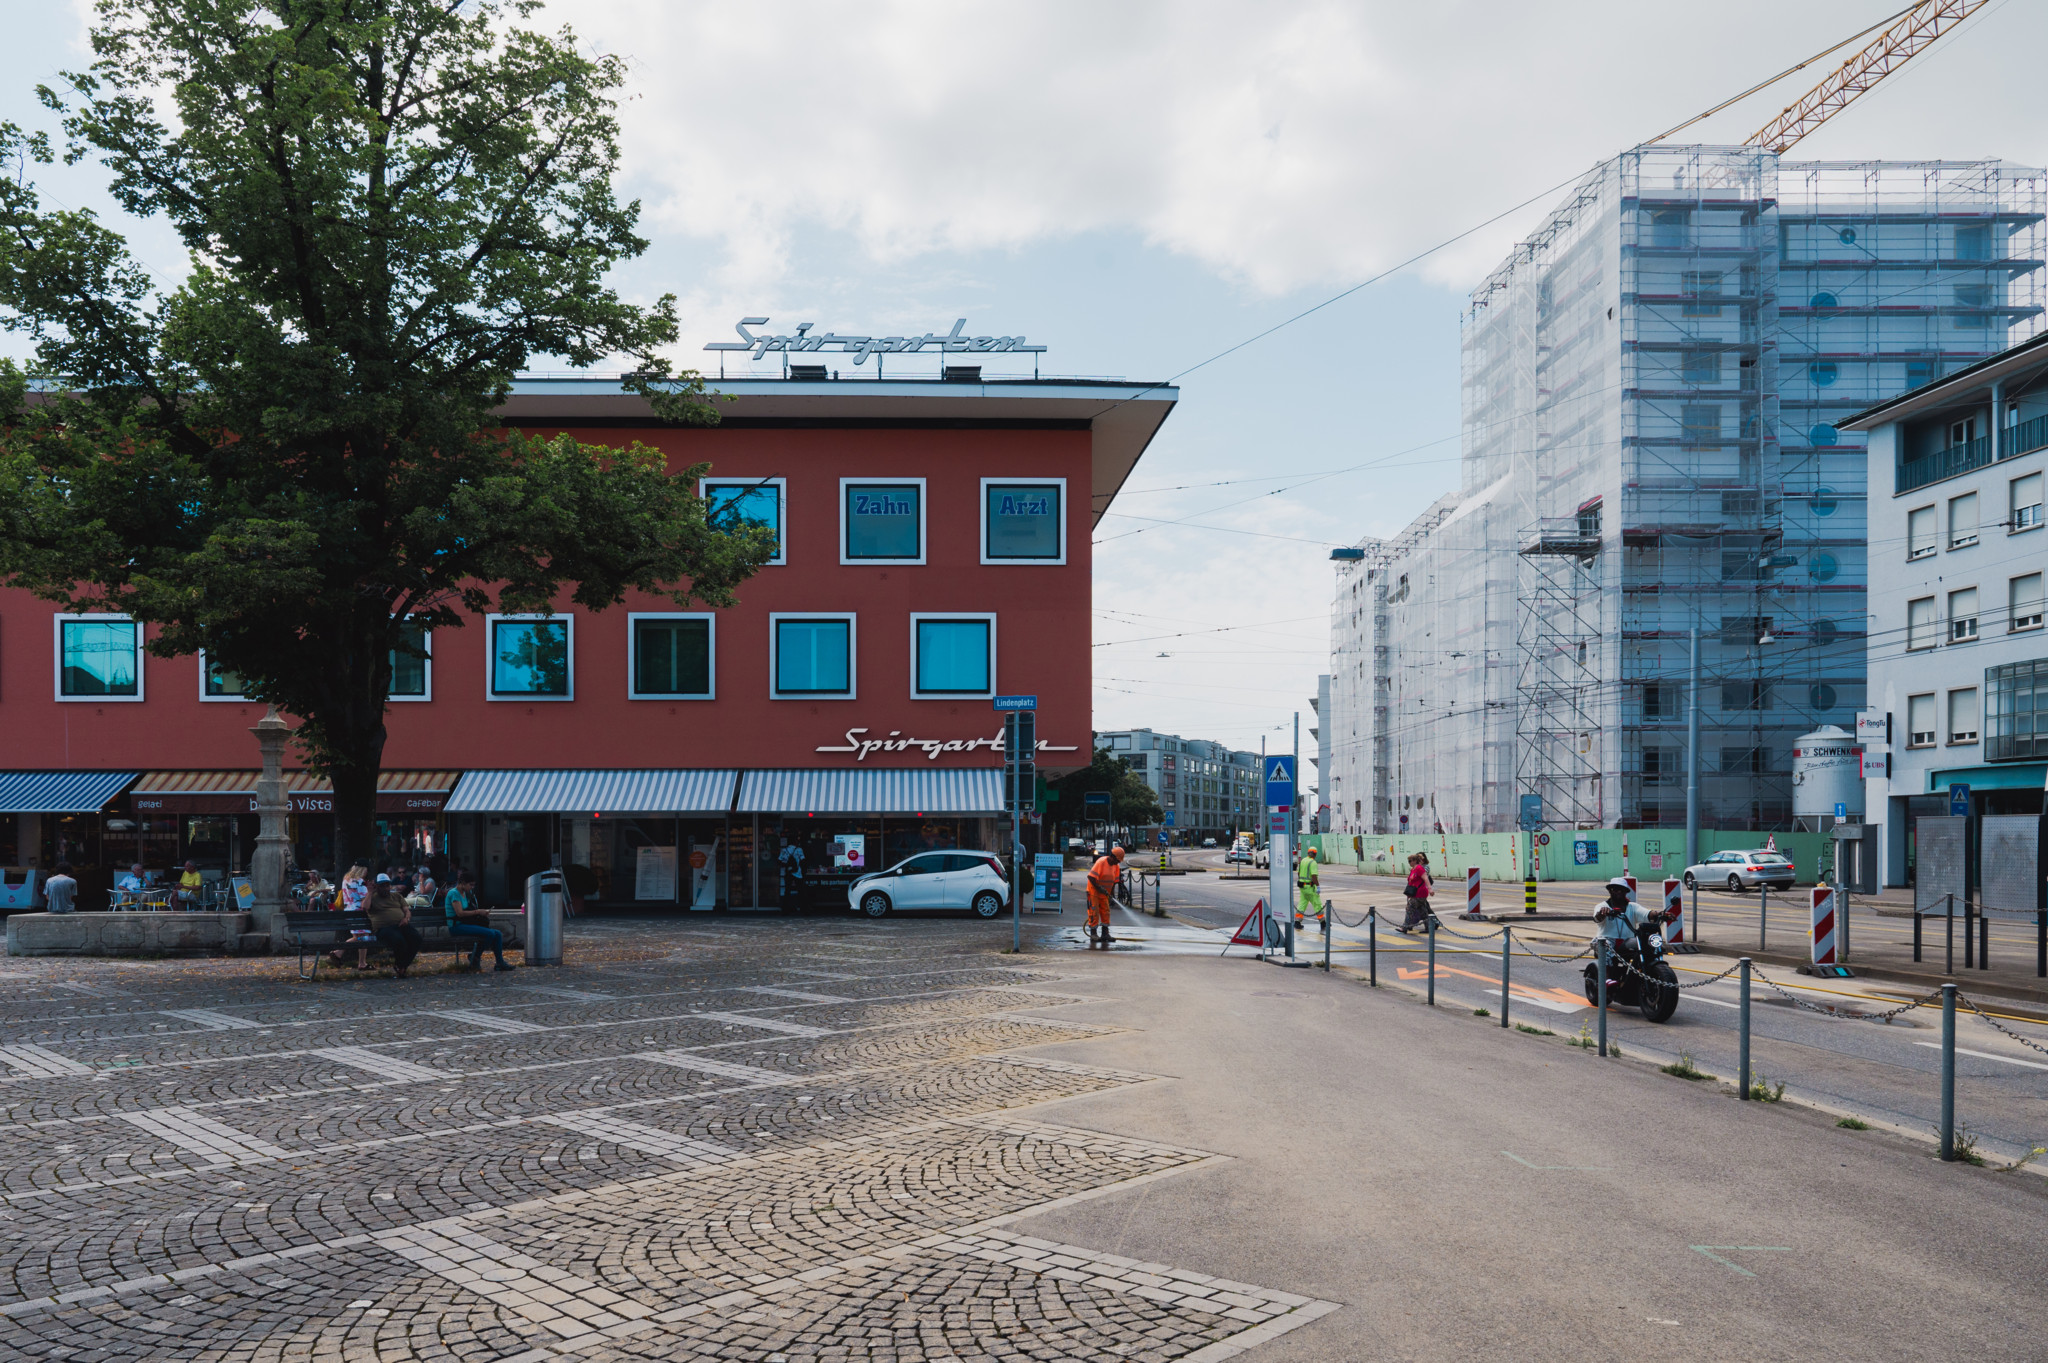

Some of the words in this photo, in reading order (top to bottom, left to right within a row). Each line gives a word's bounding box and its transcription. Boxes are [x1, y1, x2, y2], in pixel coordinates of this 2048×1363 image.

[703, 317, 1047, 365] Spirgarten
[855, 495, 911, 516] Zahn
[999, 495, 1049, 516] Arzt
[996, 698, 1034, 708] Lindenplatz
[1866, 719, 1886, 729] TongTu
[815, 728, 1078, 761] Spirgartn
[1813, 747, 1851, 757] SCHWENK
[1871, 761, 1885, 769] UBS
[137, 799, 163, 809] gelati
